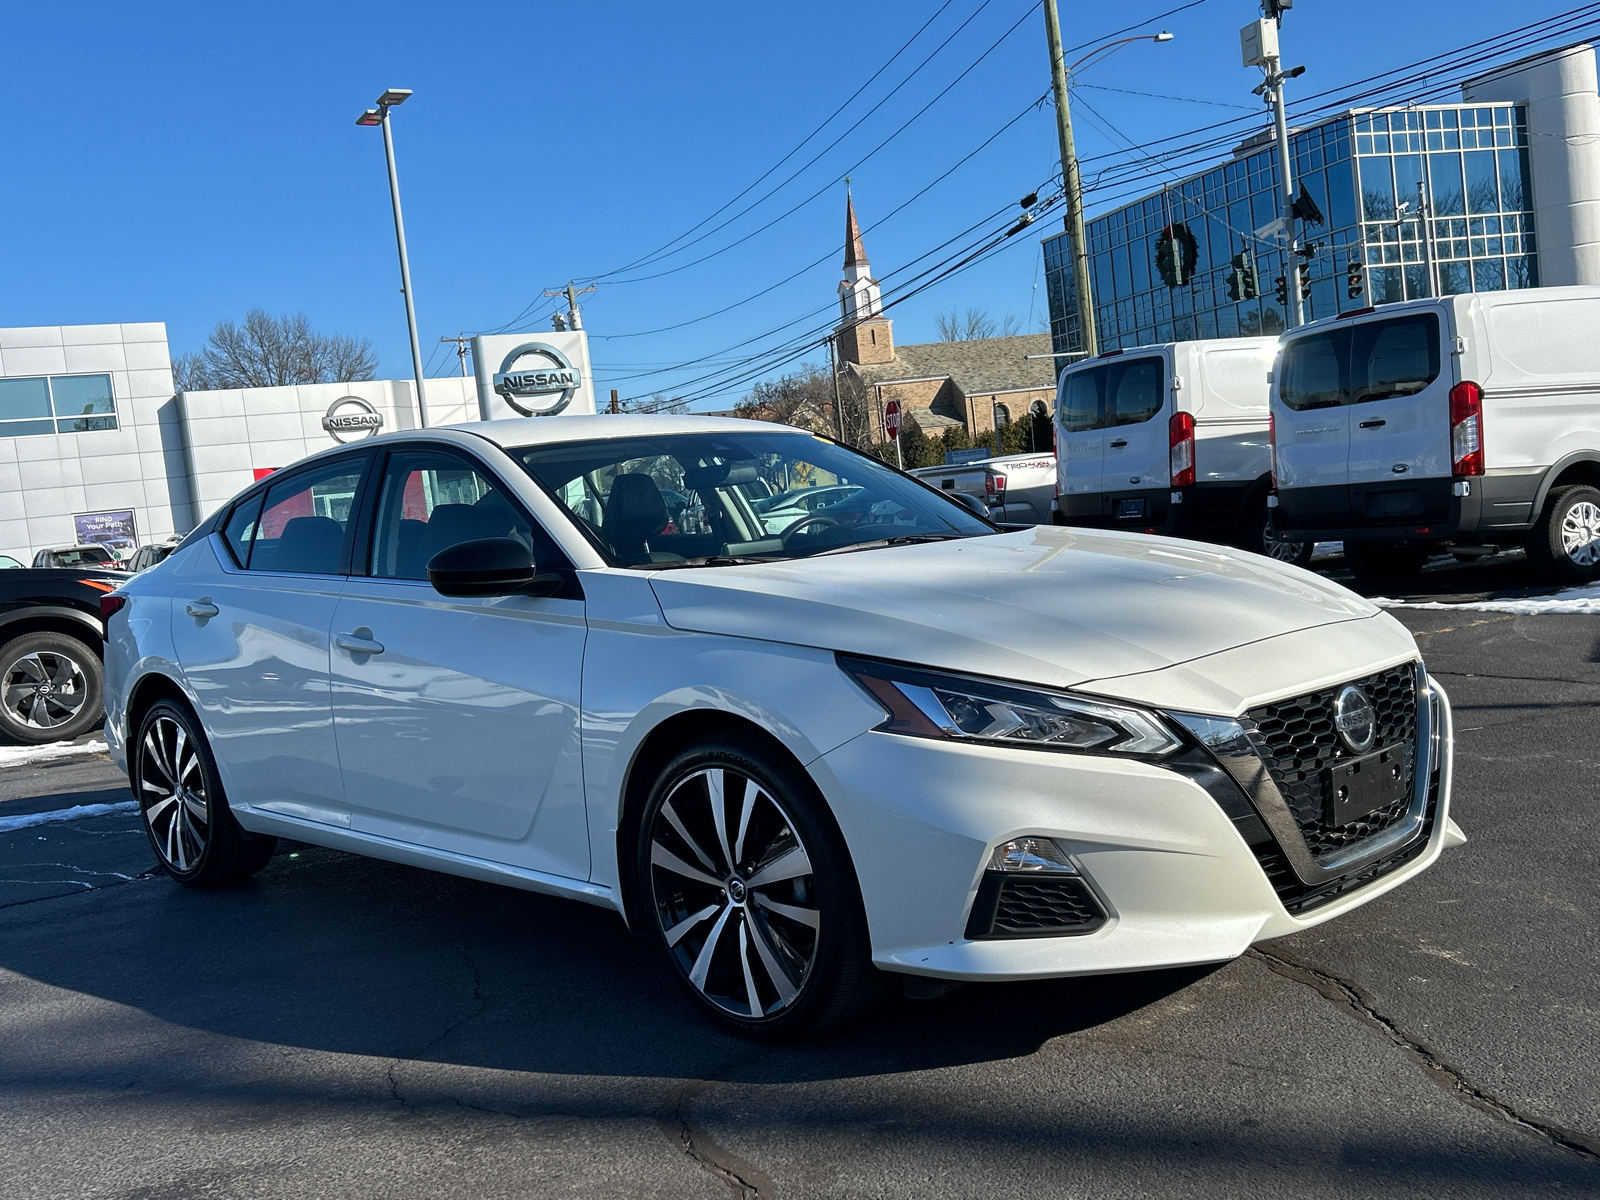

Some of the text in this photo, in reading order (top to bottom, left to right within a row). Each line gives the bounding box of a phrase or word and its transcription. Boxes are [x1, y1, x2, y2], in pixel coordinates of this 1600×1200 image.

[503, 372, 573, 389] NISSAN
[328, 415, 379, 428] NISSAN
[1002, 462, 1028, 470] TRD
[95, 515, 113, 523] FIND
